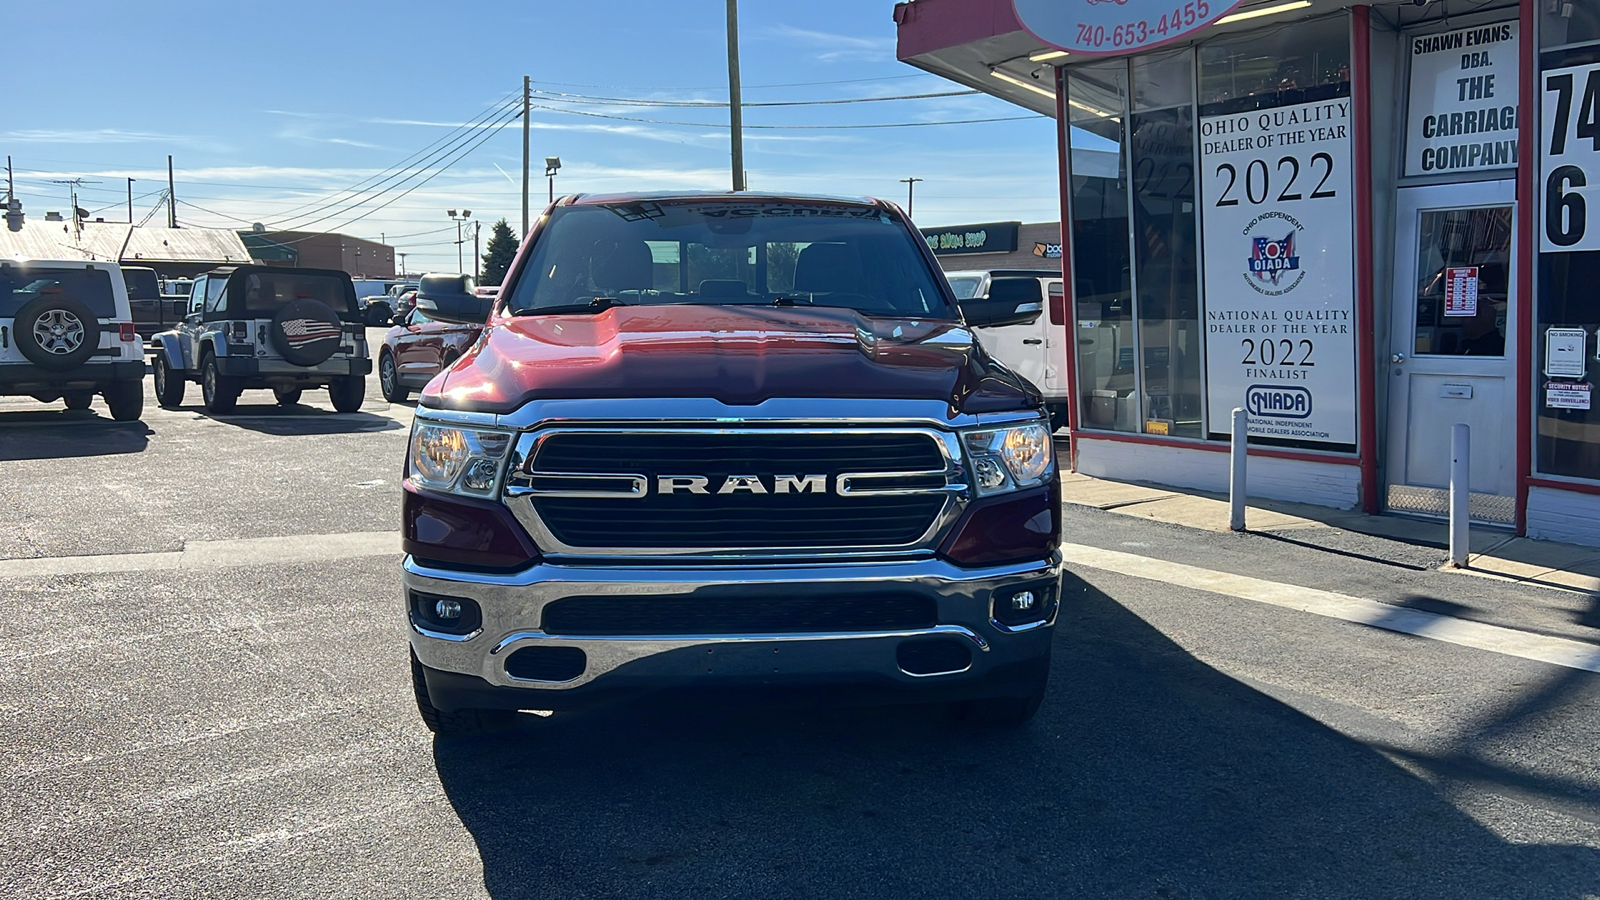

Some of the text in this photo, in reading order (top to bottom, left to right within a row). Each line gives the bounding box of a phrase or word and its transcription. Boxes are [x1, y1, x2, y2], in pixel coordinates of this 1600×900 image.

[1075, 0, 1210, 47] 740-653-4455
[1414, 25, 1513, 55] SHAWN EVANS.
[1461, 51, 1493, 70] DBA.
[1456, 74, 1495, 101] THE
[1202, 117, 1249, 136] OHIO
[1258, 102, 1349, 131] QUALITY
[1422, 105, 1519, 138] CARRIAG
[1204, 138, 1253, 155] DEALER
[1257, 135, 1274, 148] OF
[1277, 131, 1305, 146] THE
[1309, 125, 1346, 142] YEAR
[1216, 152, 1336, 207] 2022
[1243, 212, 1305, 235] OHIO INDEPENDENT
[965, 230, 986, 248] SHOP
[1047, 244, 1062, 252] boo
[1254, 258, 1290, 270] OIADA
[1209, 310, 1349, 322] NATIONAL QUALITY
[1210, 324, 1347, 334] DEALER OF THE YEAR
[1242, 338, 1315, 366] 2022
[1246, 369, 1308, 380] FINALIST
[1252, 392, 1305, 413] NIADA
[657, 475, 828, 494] RAM
